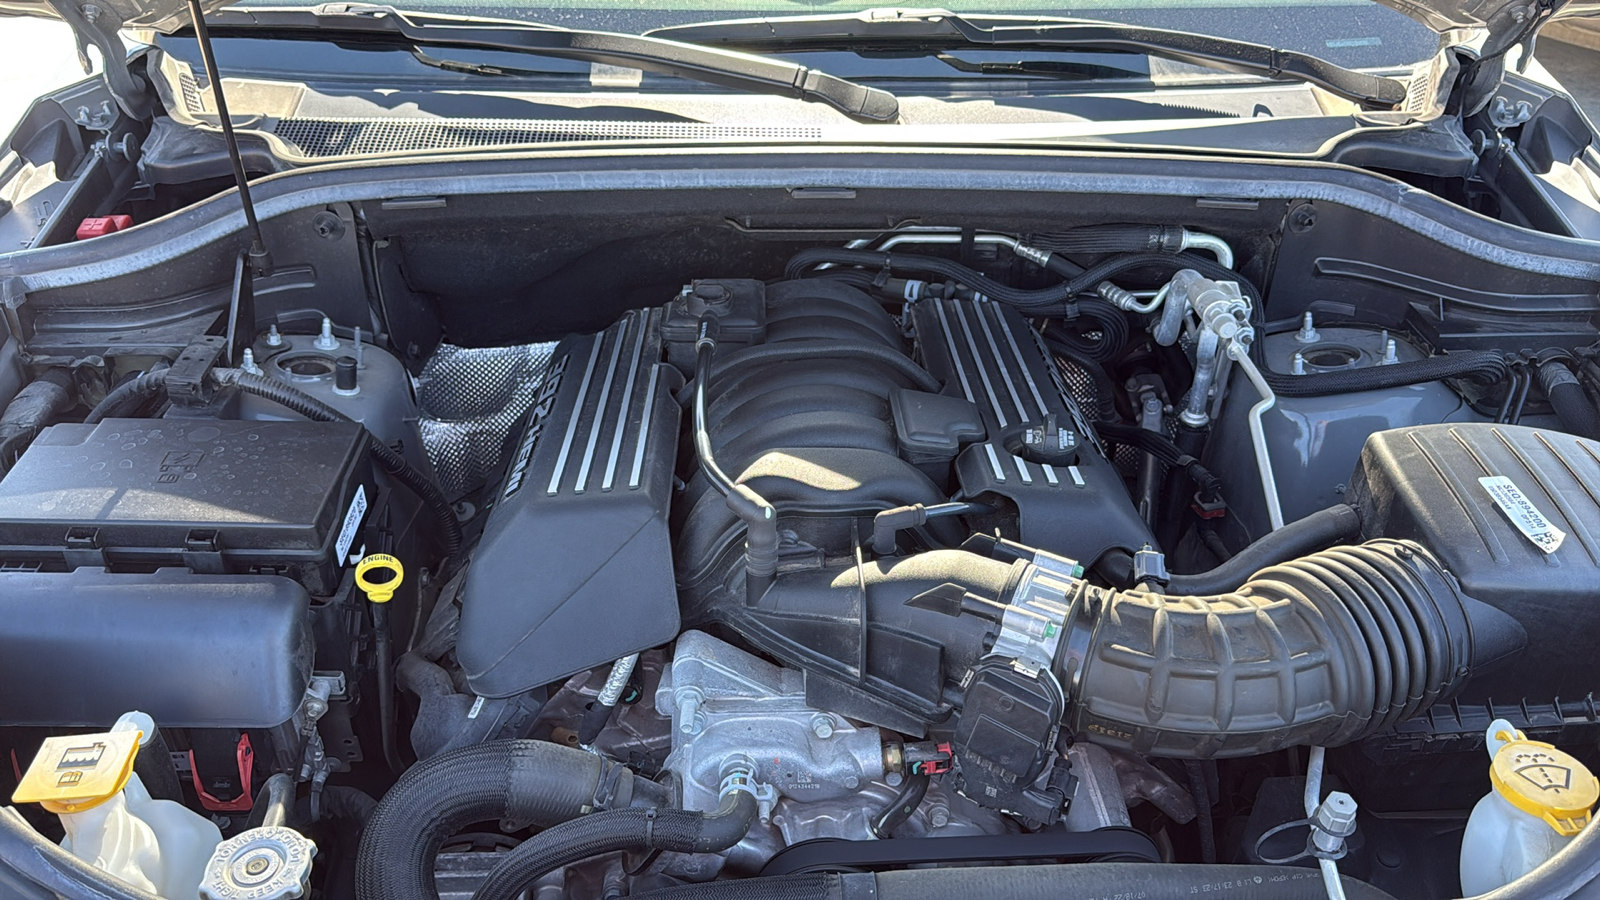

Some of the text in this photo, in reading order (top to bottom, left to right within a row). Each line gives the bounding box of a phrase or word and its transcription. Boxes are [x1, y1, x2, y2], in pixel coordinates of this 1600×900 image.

[505, 424, 544, 497] HEMI
[363, 555, 394, 565] ENGINE
[247, 880, 284, 899] KEEP
